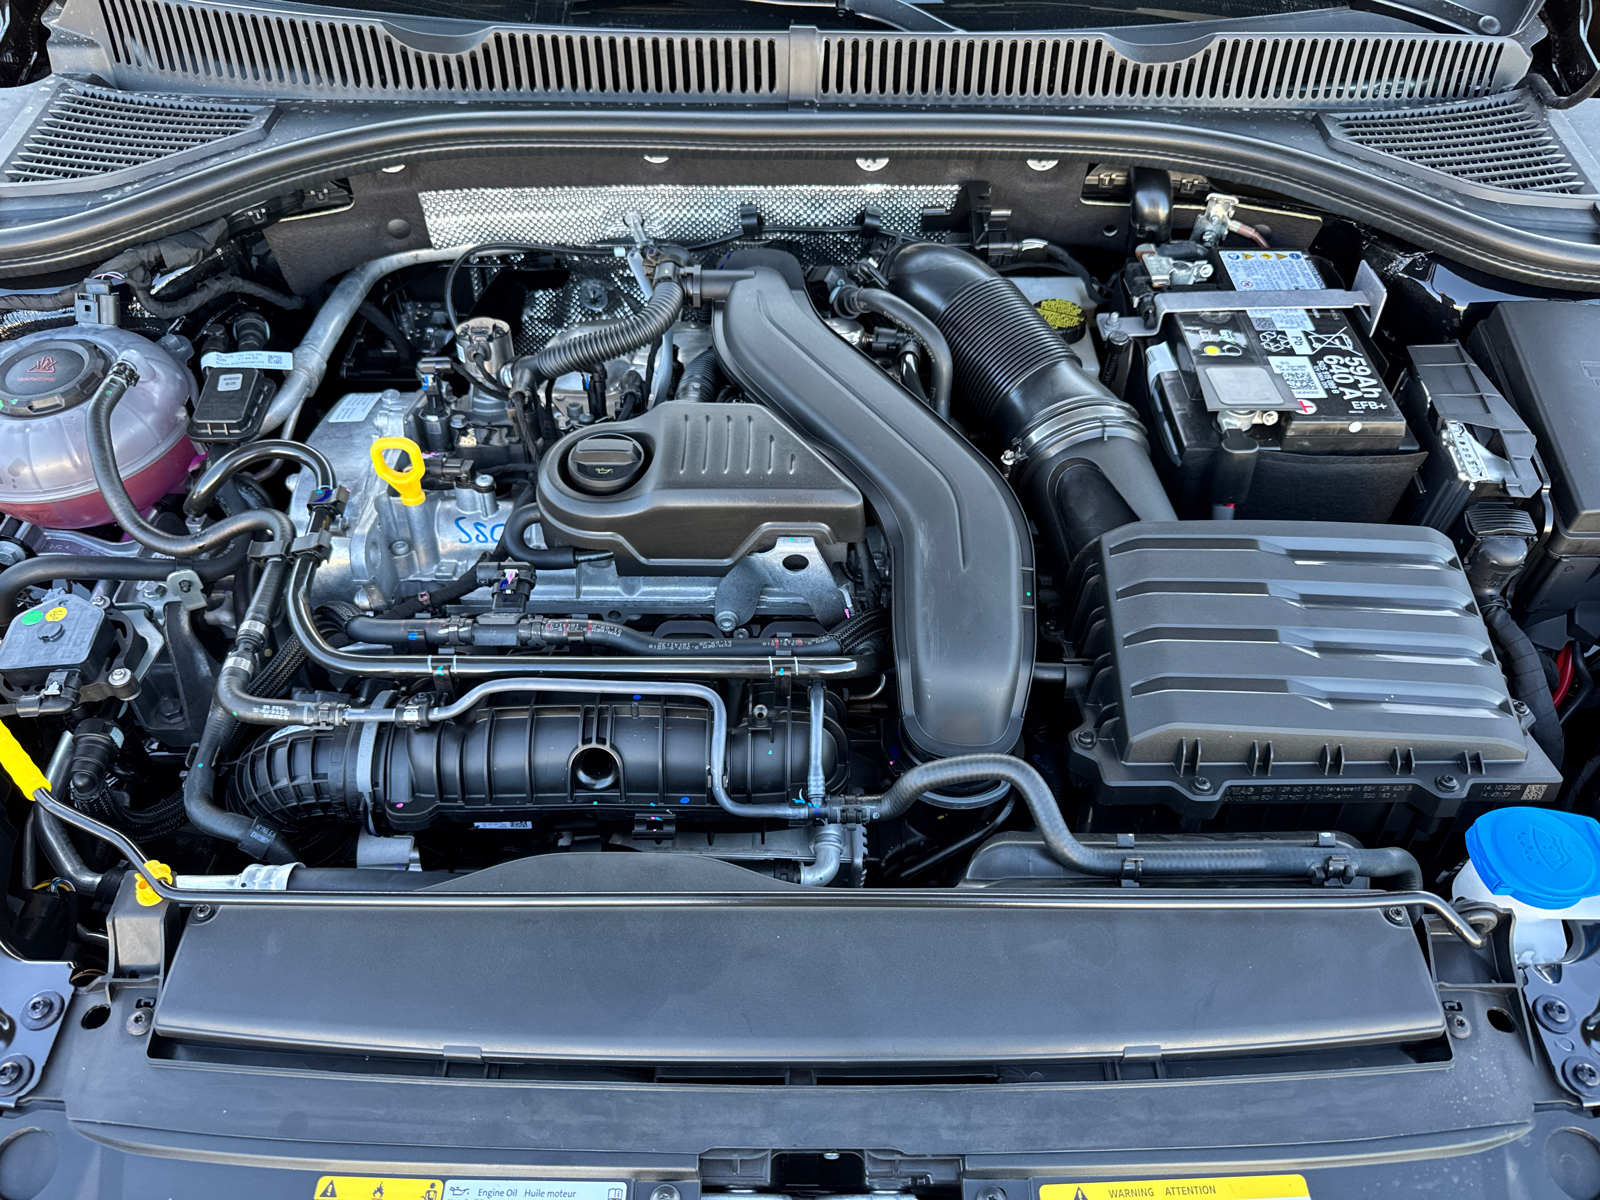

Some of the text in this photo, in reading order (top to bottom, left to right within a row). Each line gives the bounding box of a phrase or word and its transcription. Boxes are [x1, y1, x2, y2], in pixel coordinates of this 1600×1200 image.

[1291, 335, 1303, 346] Pb
[1323, 355, 1355, 384] 640
[1344, 356, 1383, 398] 59Ah
[1338, 386, 1363, 400] A
[1351, 400, 1387, 409] EFB+
[478, 1188, 577, 1199] Engine Oil Huile moteur
[1108, 1185, 1217, 1198] WARNING ATTENTION
